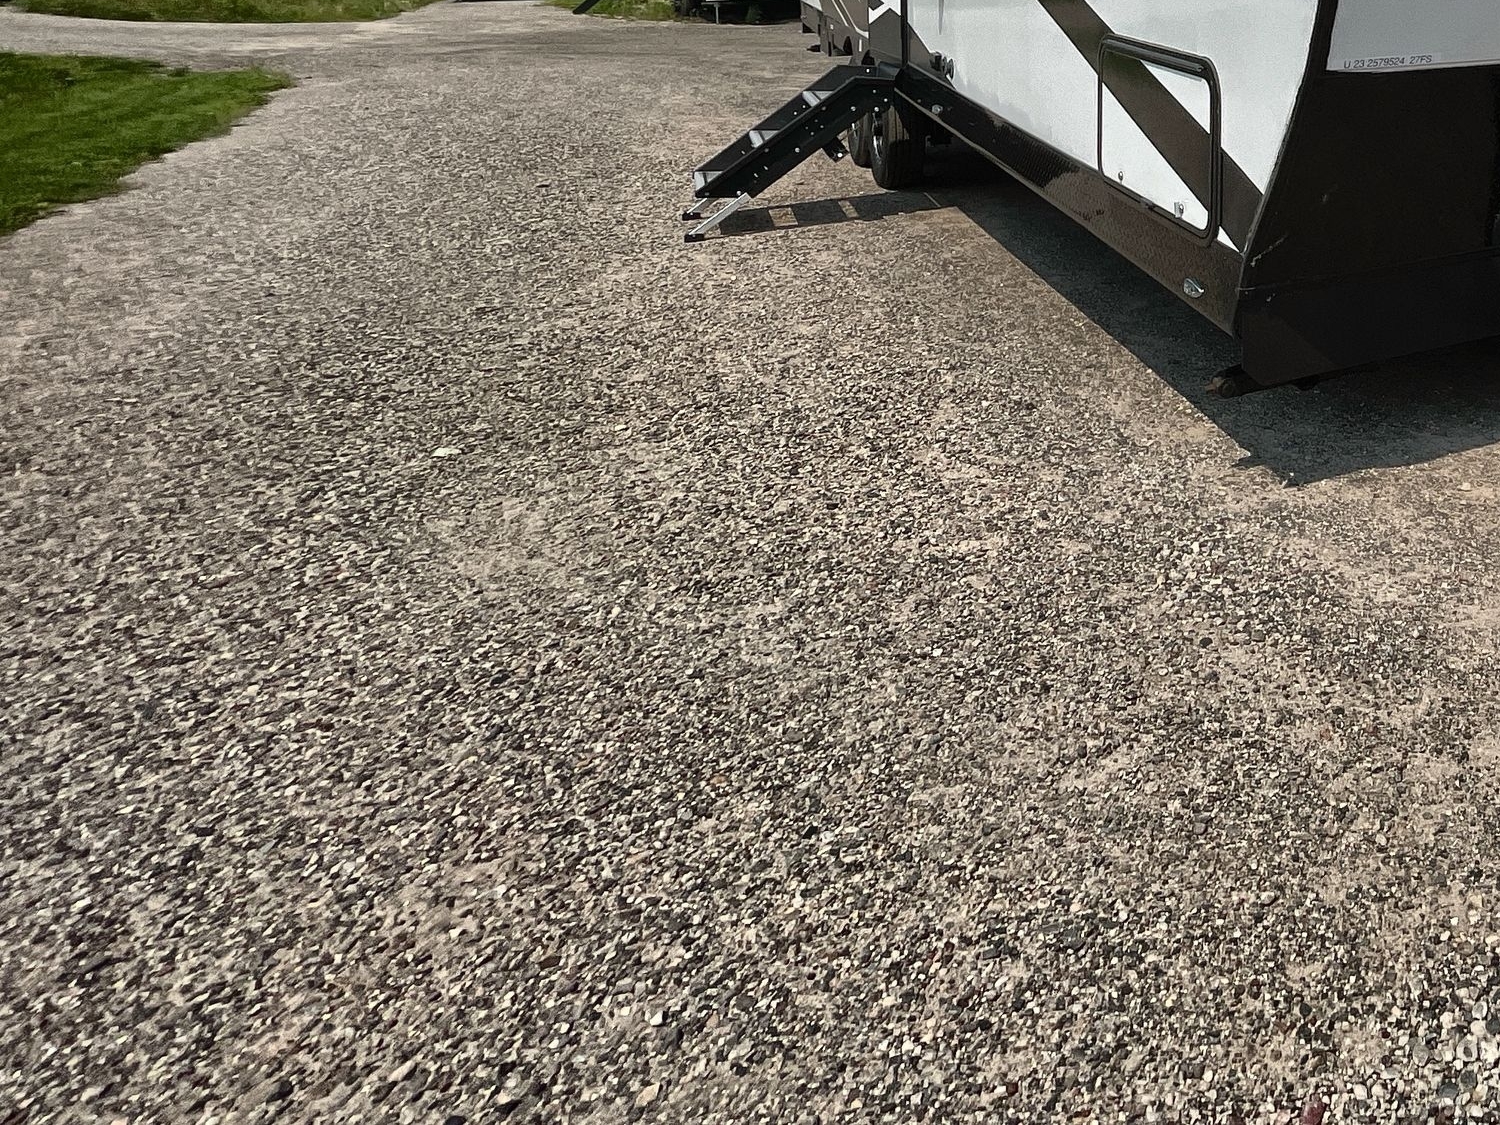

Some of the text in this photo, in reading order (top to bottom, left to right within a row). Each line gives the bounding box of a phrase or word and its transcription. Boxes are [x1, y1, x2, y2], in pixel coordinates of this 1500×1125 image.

[1343, 55, 1433, 69] U 23 2579524 27FS
